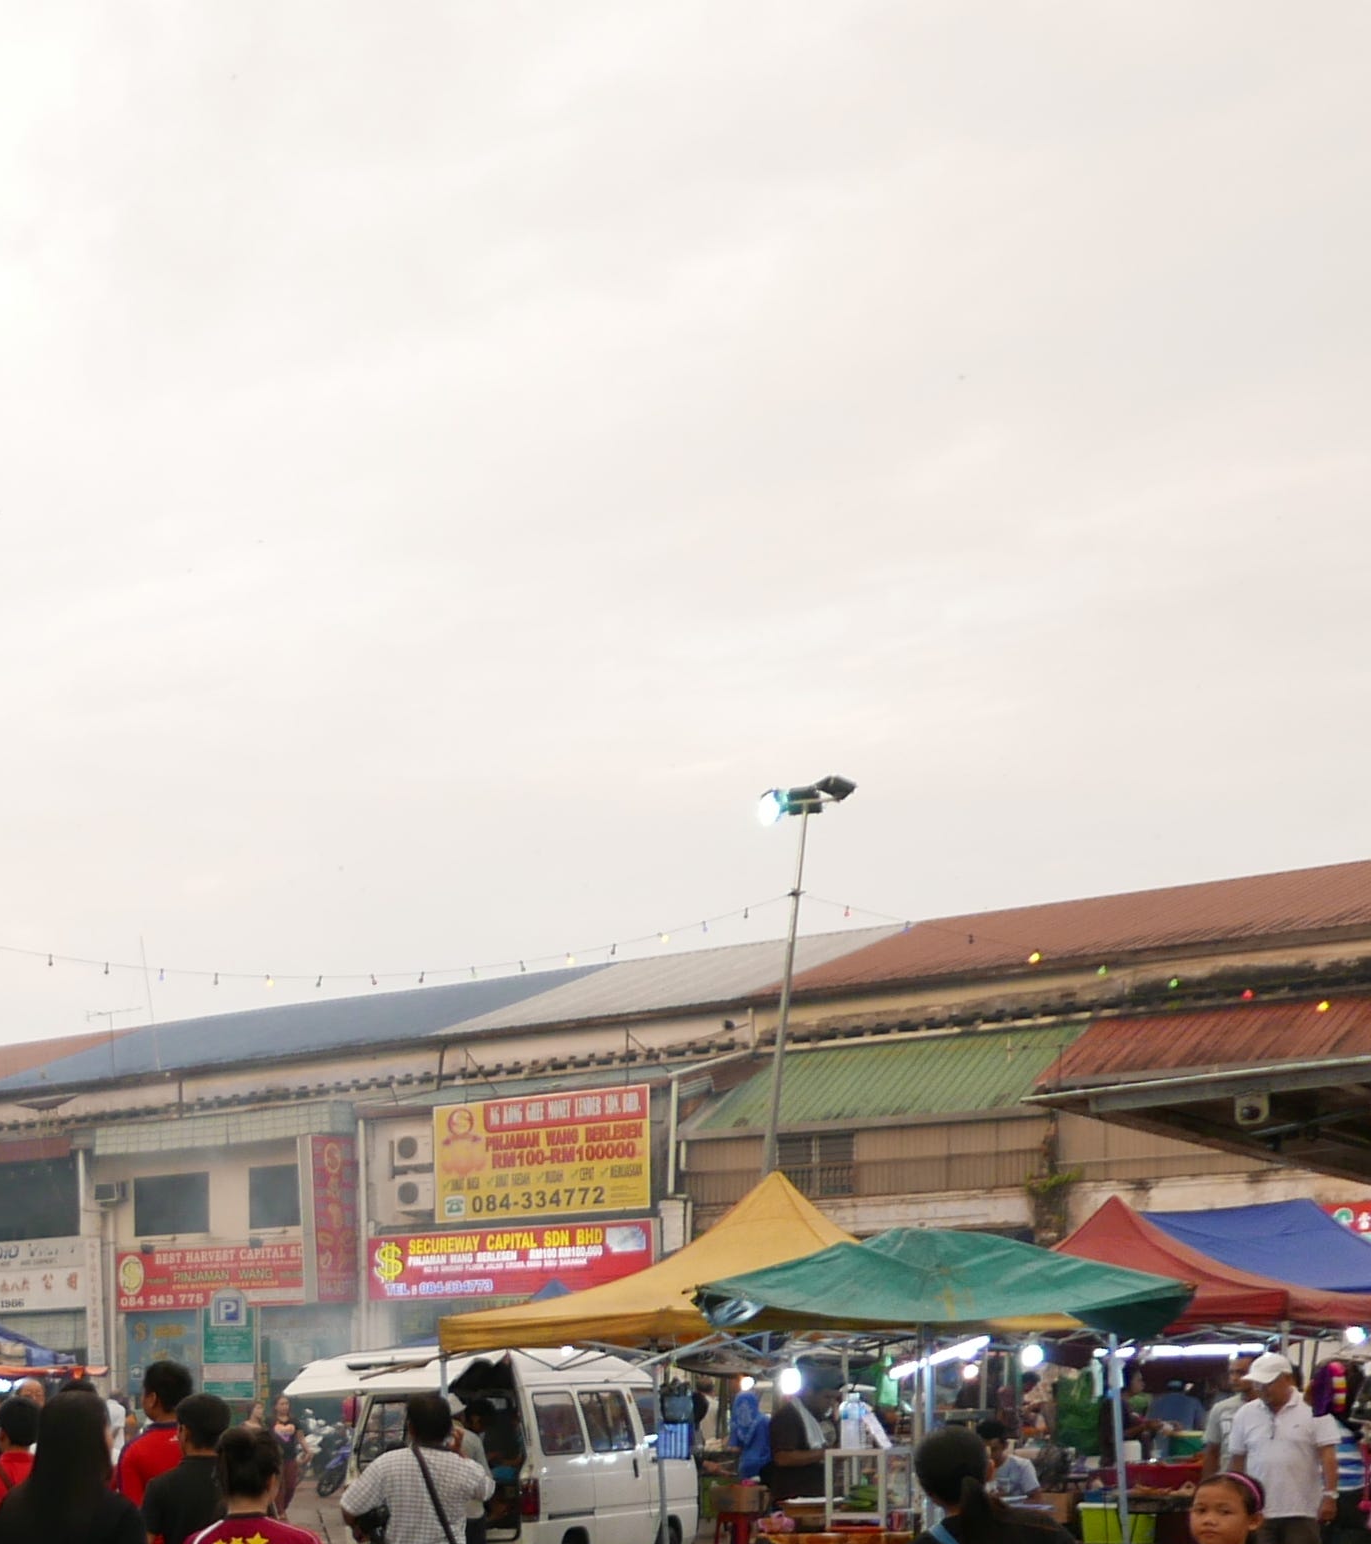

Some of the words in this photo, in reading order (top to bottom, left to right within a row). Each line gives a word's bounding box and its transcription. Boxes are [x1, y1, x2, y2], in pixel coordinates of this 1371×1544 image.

[485, 1130, 540, 1151] PINJAMAN
[545, 1128, 579, 1146] WANG
[585, 1121, 643, 1141] BERLESEN
[472, 1186, 605, 1213] 084-334772
[409, 1234, 480, 1255] SECUREWAY
[486, 1231, 537, 1250] CAPITAL
[543, 1229, 569, 1247] SDN
[576, 1227, 603, 1244] BHD
[155, 1253, 182, 1265] BEST
[186, 1250, 235, 1264] HARVEST
[240, 1246, 285, 1260] CAPITAL
[408, 1252, 447, 1267] PINJAMAN
[450, 1251, 473, 1264] WANG
[476, 1249, 517, 1263] BERLESEN
[173, 1270, 230, 1282] PINJAMAN
[238, 1267, 273, 1280] WANG
[385, 1284, 410, 1295] TEL
[120, 1297, 144, 1307] 084
